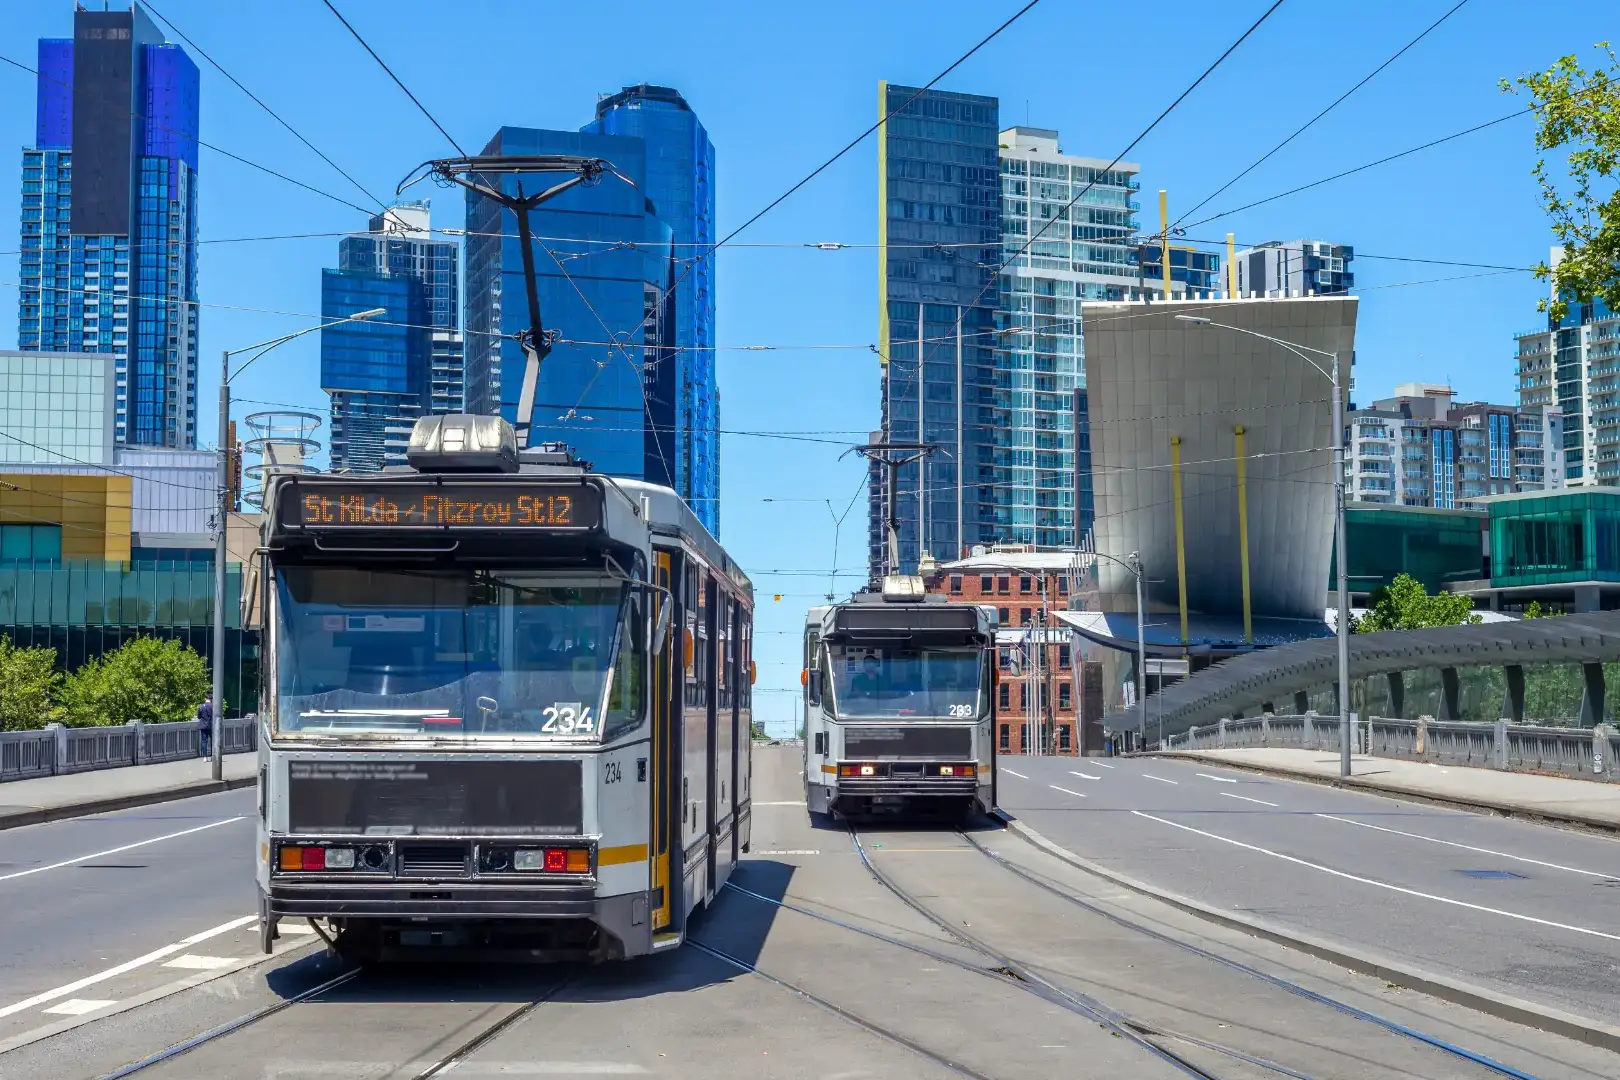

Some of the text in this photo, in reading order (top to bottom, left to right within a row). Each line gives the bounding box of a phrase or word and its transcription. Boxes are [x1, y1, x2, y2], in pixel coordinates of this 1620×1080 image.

[305, 495, 333, 521] St
[340, 495, 398, 522] Kilda
[423, 495, 511, 523] Fitzroy
[541, 706, 594, 733] 234
[604, 761, 622, 785] 234
